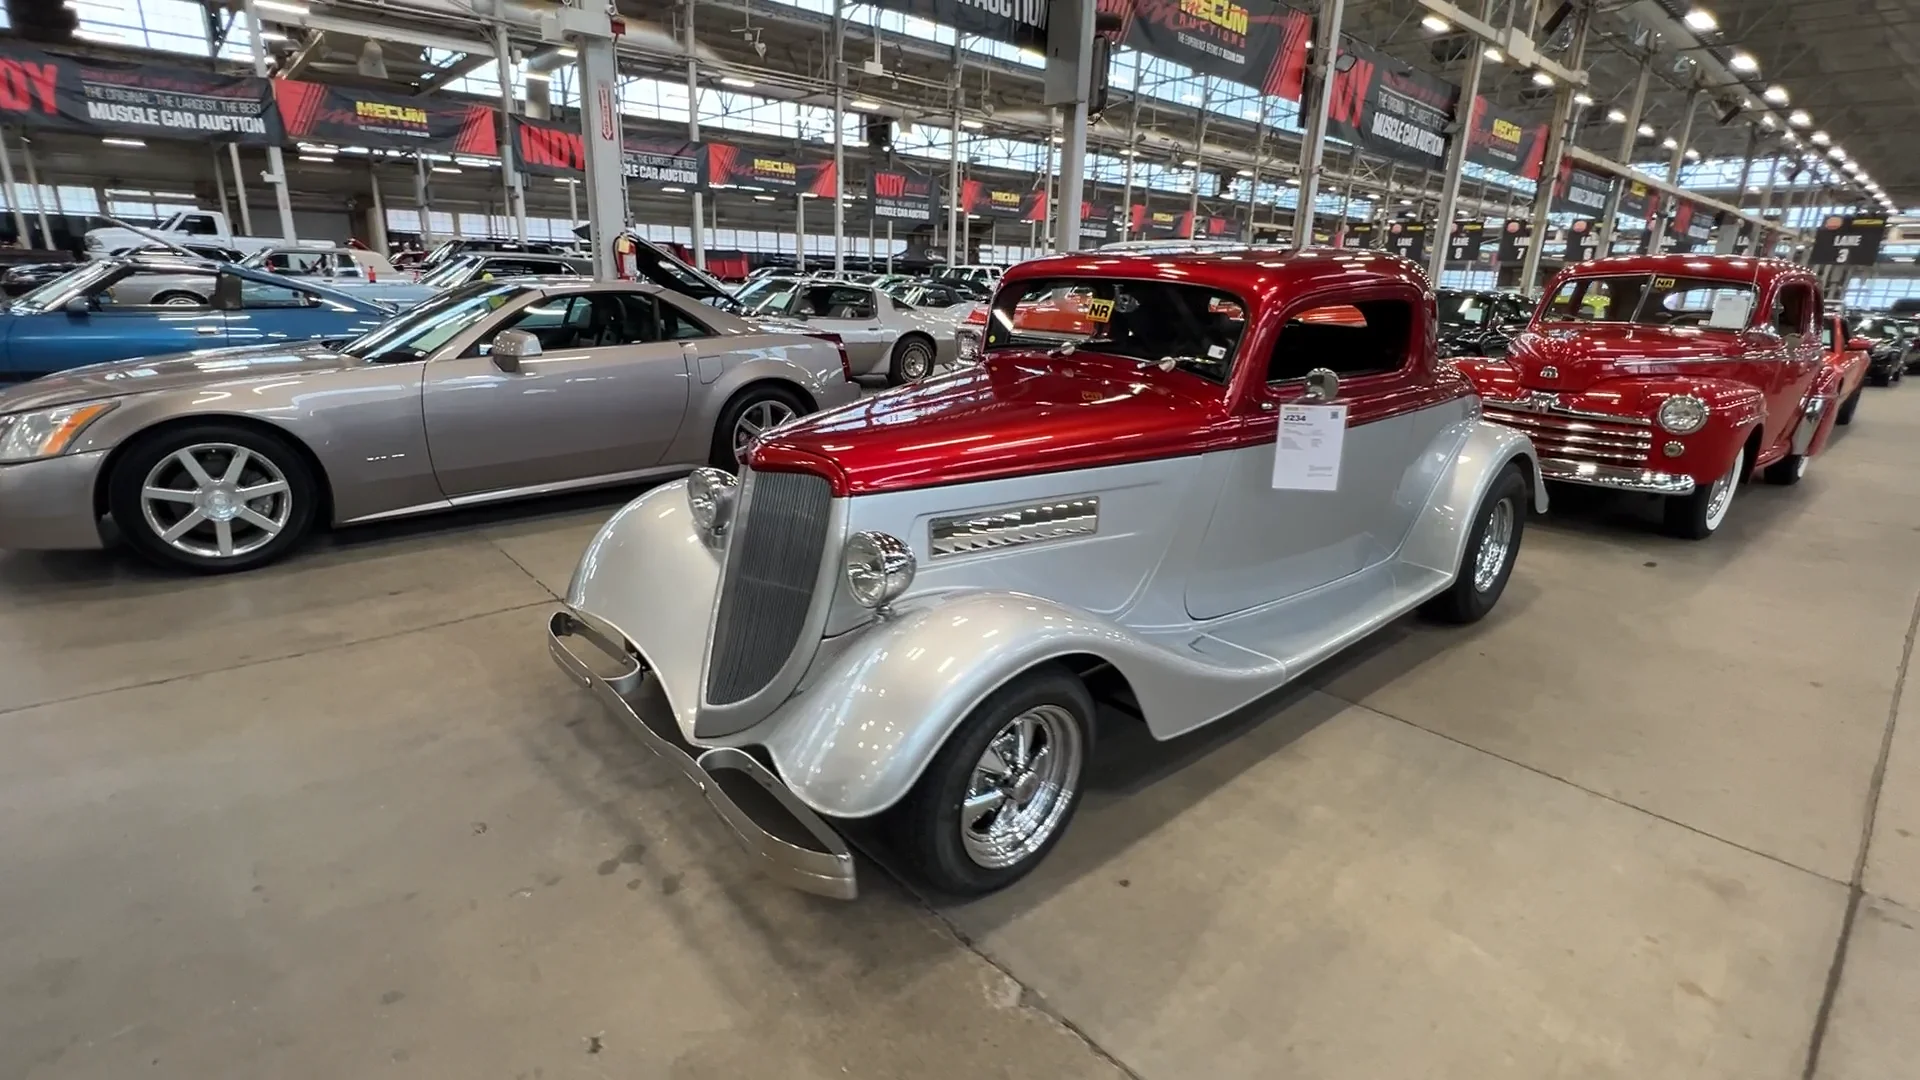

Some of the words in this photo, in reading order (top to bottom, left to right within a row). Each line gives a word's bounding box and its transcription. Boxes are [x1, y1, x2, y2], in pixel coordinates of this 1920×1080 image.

[971, 0, 1047, 30] CTION
[220, 101, 238, 113] THE
[239, 103, 262, 114] BEST
[355, 100, 429, 124] MECUM
[87, 101, 160, 126] MUSCLE
[160, 109, 197, 129] CAR
[199, 113, 267, 134] AUCTION
[519, 123, 587, 170] INDY
[753, 158, 797, 175] MECUM
[639, 165, 659, 180] CAR
[659, 168, 698, 184] AUCTION
[875, 172, 906, 197] INDY
[1396, 237, 1413, 247] LANE
[1451, 236, 1470, 246] LANE
[1513, 236, 1531, 246] LAN
[1833, 235, 1863, 246] LANE
[1454, 247, 1464, 259] 8
[1516, 247, 1526, 260] 7
[1836, 248, 1850, 263] 3
[1088, 303, 1111, 318] NR
[1283, 414, 1307, 422] J234
